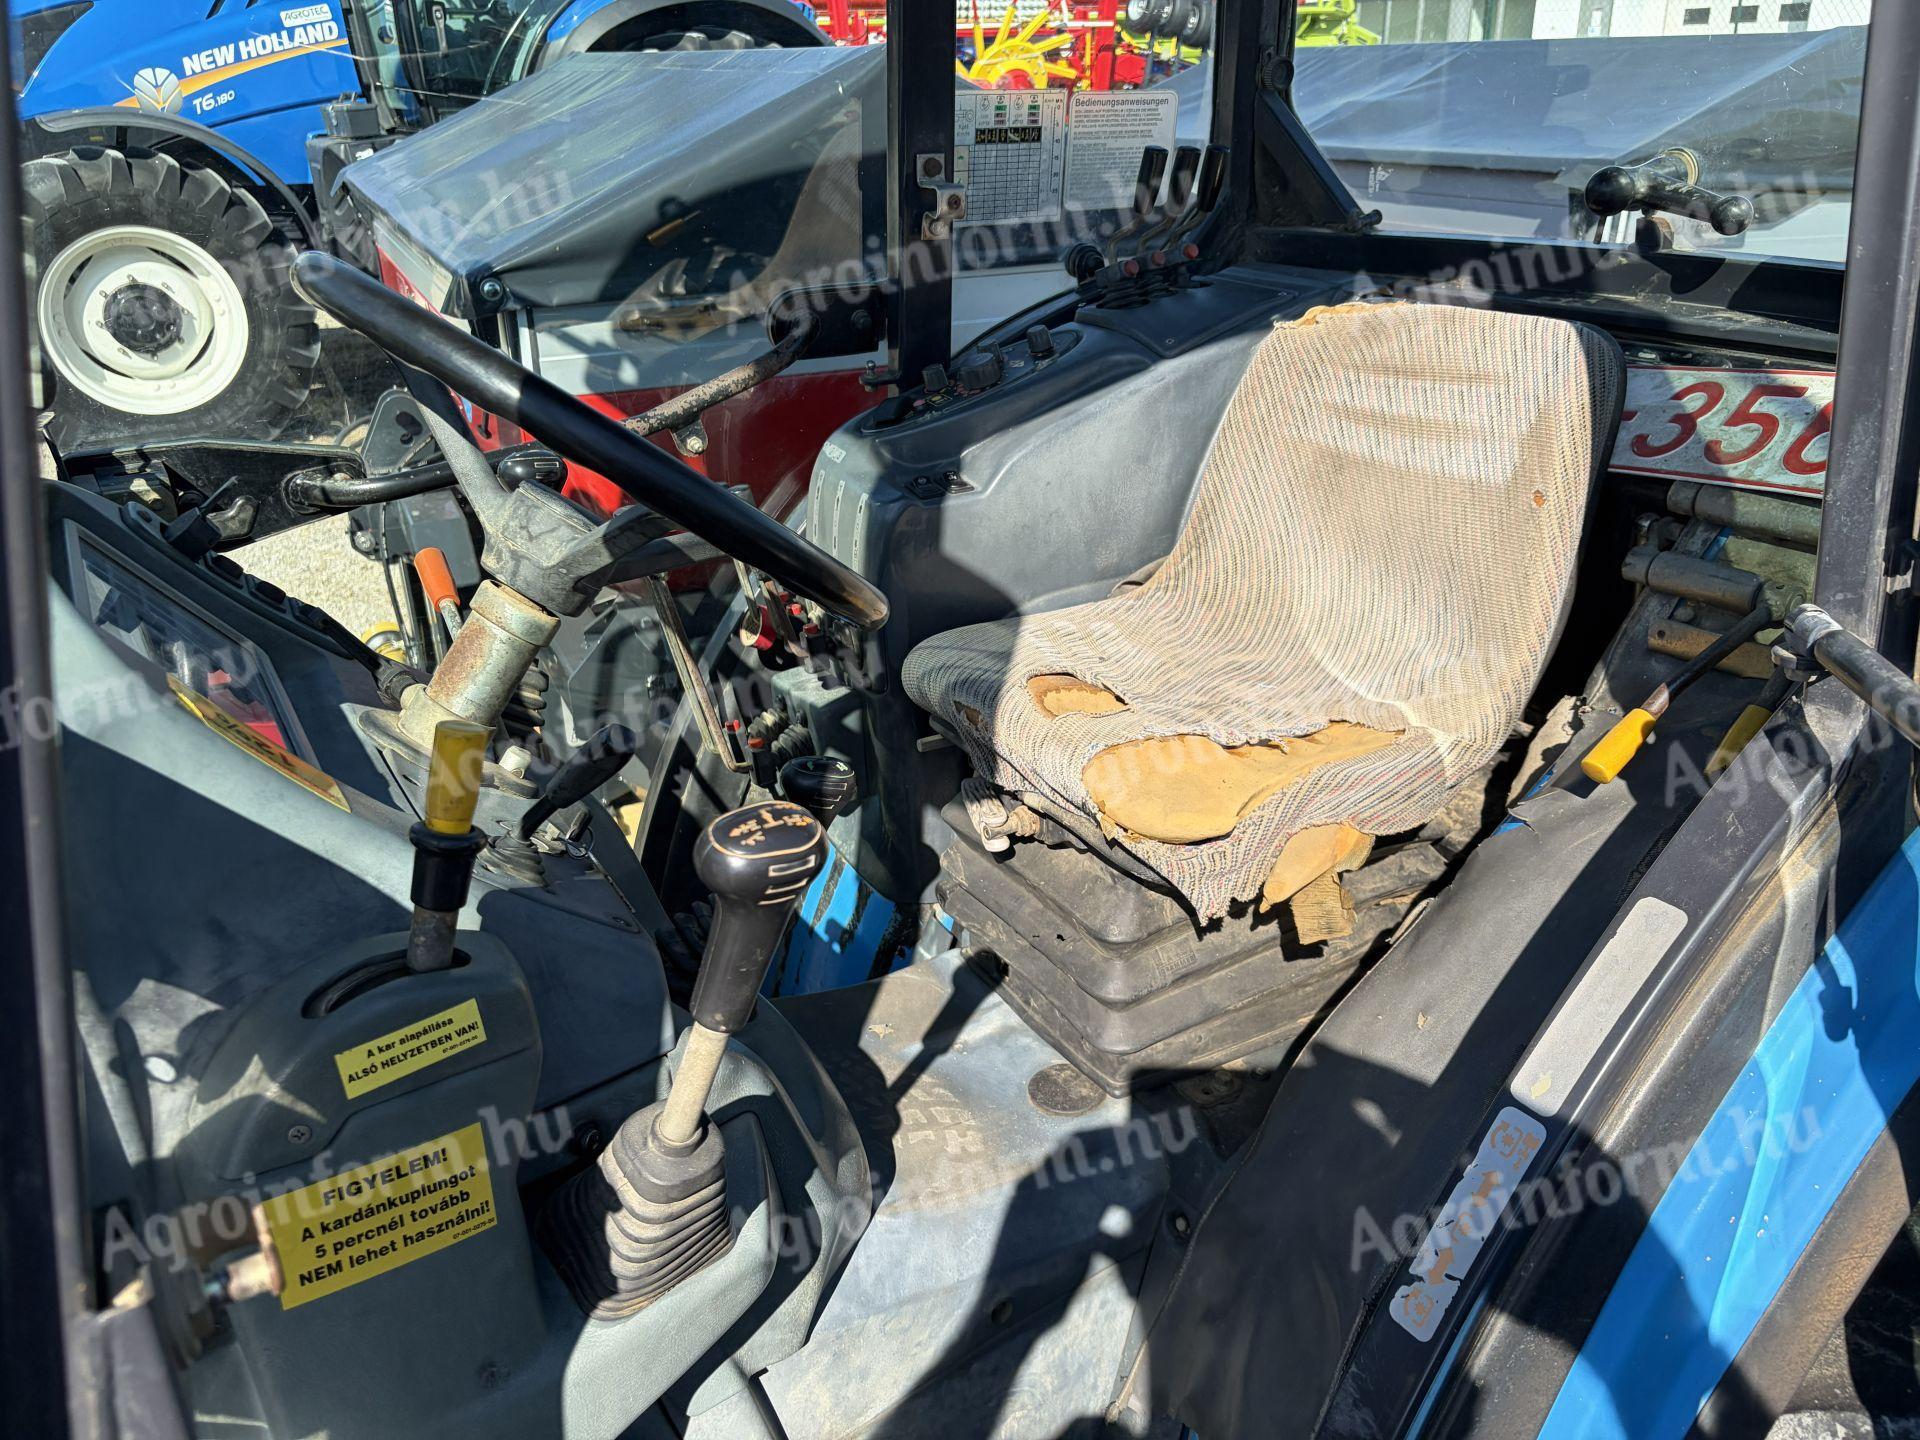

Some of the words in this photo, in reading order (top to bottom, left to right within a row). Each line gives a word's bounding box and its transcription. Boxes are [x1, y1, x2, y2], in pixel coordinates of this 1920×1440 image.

[284, 6, 329, 21] AGROTEC
[182, 43, 235, 76] NEW
[239, 20, 339, 60] HOLLAND
[192, 90, 236, 115] T6.180
[1074, 96, 1169, 108] Bedienungsanweisungen
[348, 1062, 379, 1084] ALSÓ
[380, 1032, 453, 1070] HELYZETBEN
[454, 1020, 479, 1038] VAN!
[367, 1048, 376, 1059] A
[377, 1041, 397, 1054] kar
[399, 1017, 454, 1046] alapállása
[301, 1227, 316, 1243] A
[320, 1164, 477, 1235] kardánkuplungot
[323, 1147, 449, 1206] FIGYELEM!
[298, 1263, 344, 1287] NEM
[349, 1240, 398, 1270] lehet
[402, 1200, 491, 1249] használni!
[315, 1244, 327, 1260] 5
[333, 1218, 405, 1255] percnél
[410, 1189, 471, 1223] tovább
